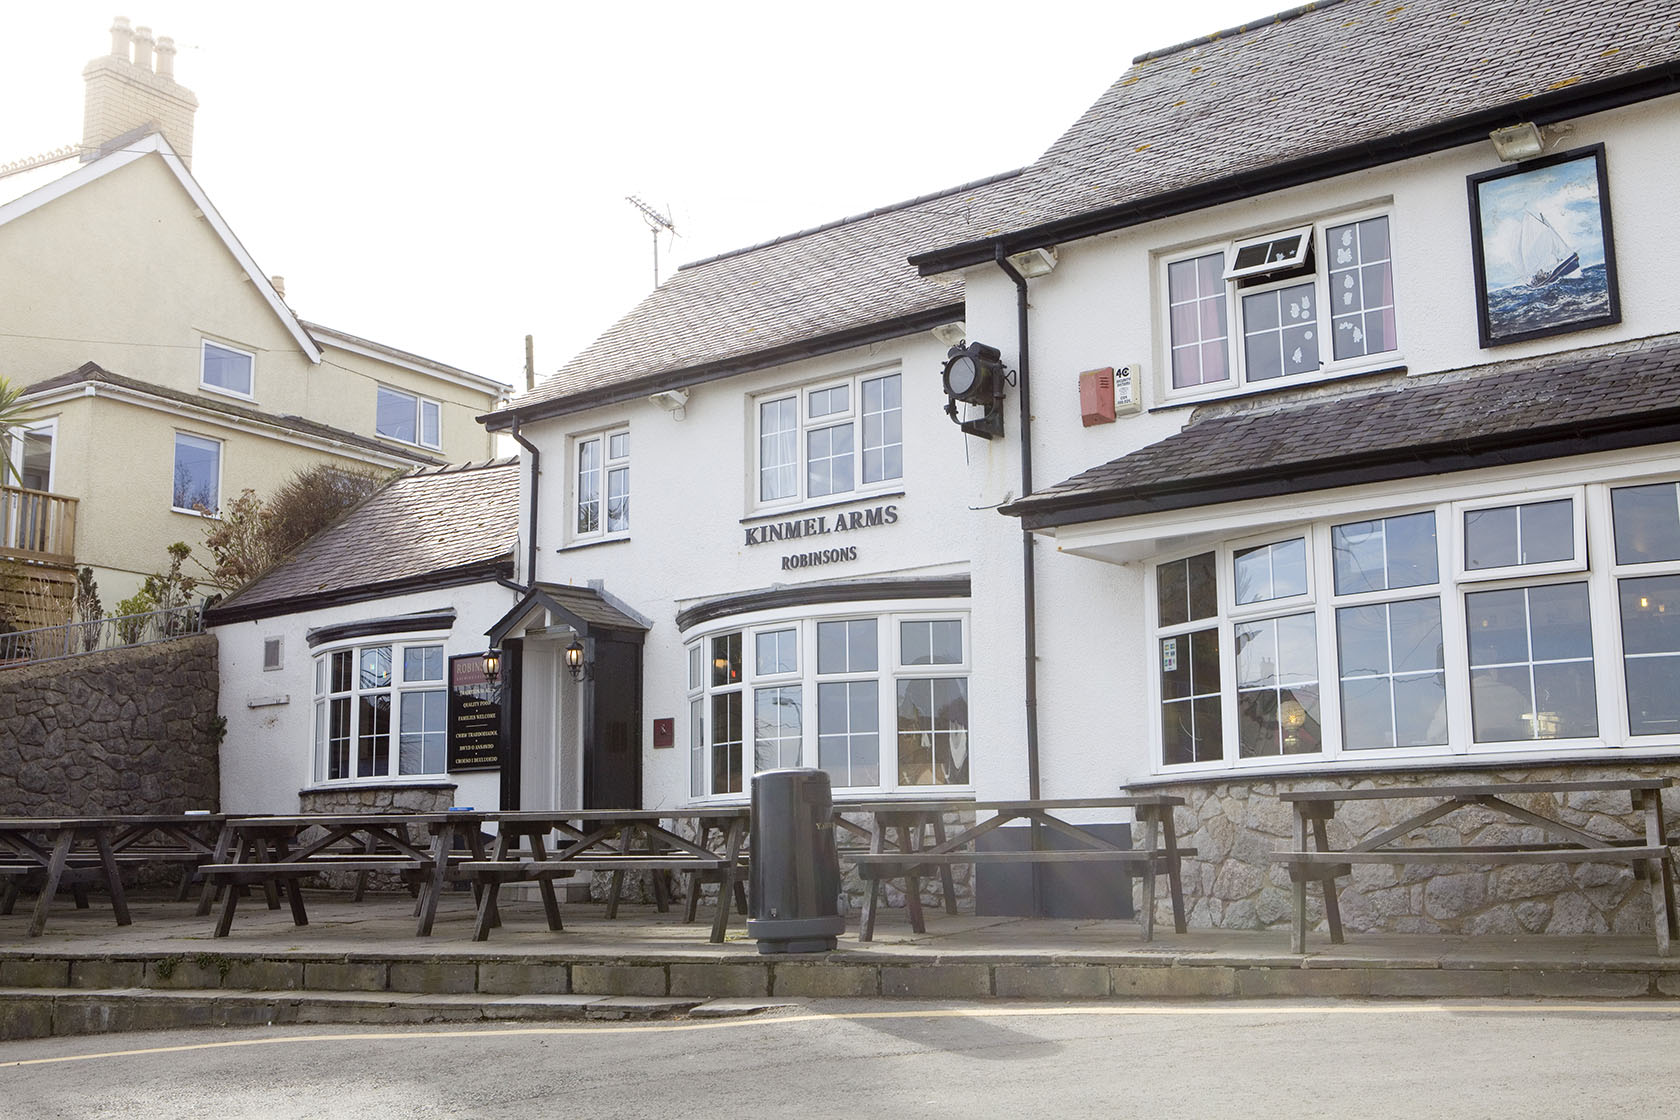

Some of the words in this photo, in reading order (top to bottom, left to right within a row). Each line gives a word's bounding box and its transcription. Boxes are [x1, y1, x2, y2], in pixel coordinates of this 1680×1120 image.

[745, 516, 830, 546] KINMEL
[834, 505, 898, 532] ARMS
[781, 546, 857, 570] ROBINSONS
[456, 661, 483, 674] ROBINS
